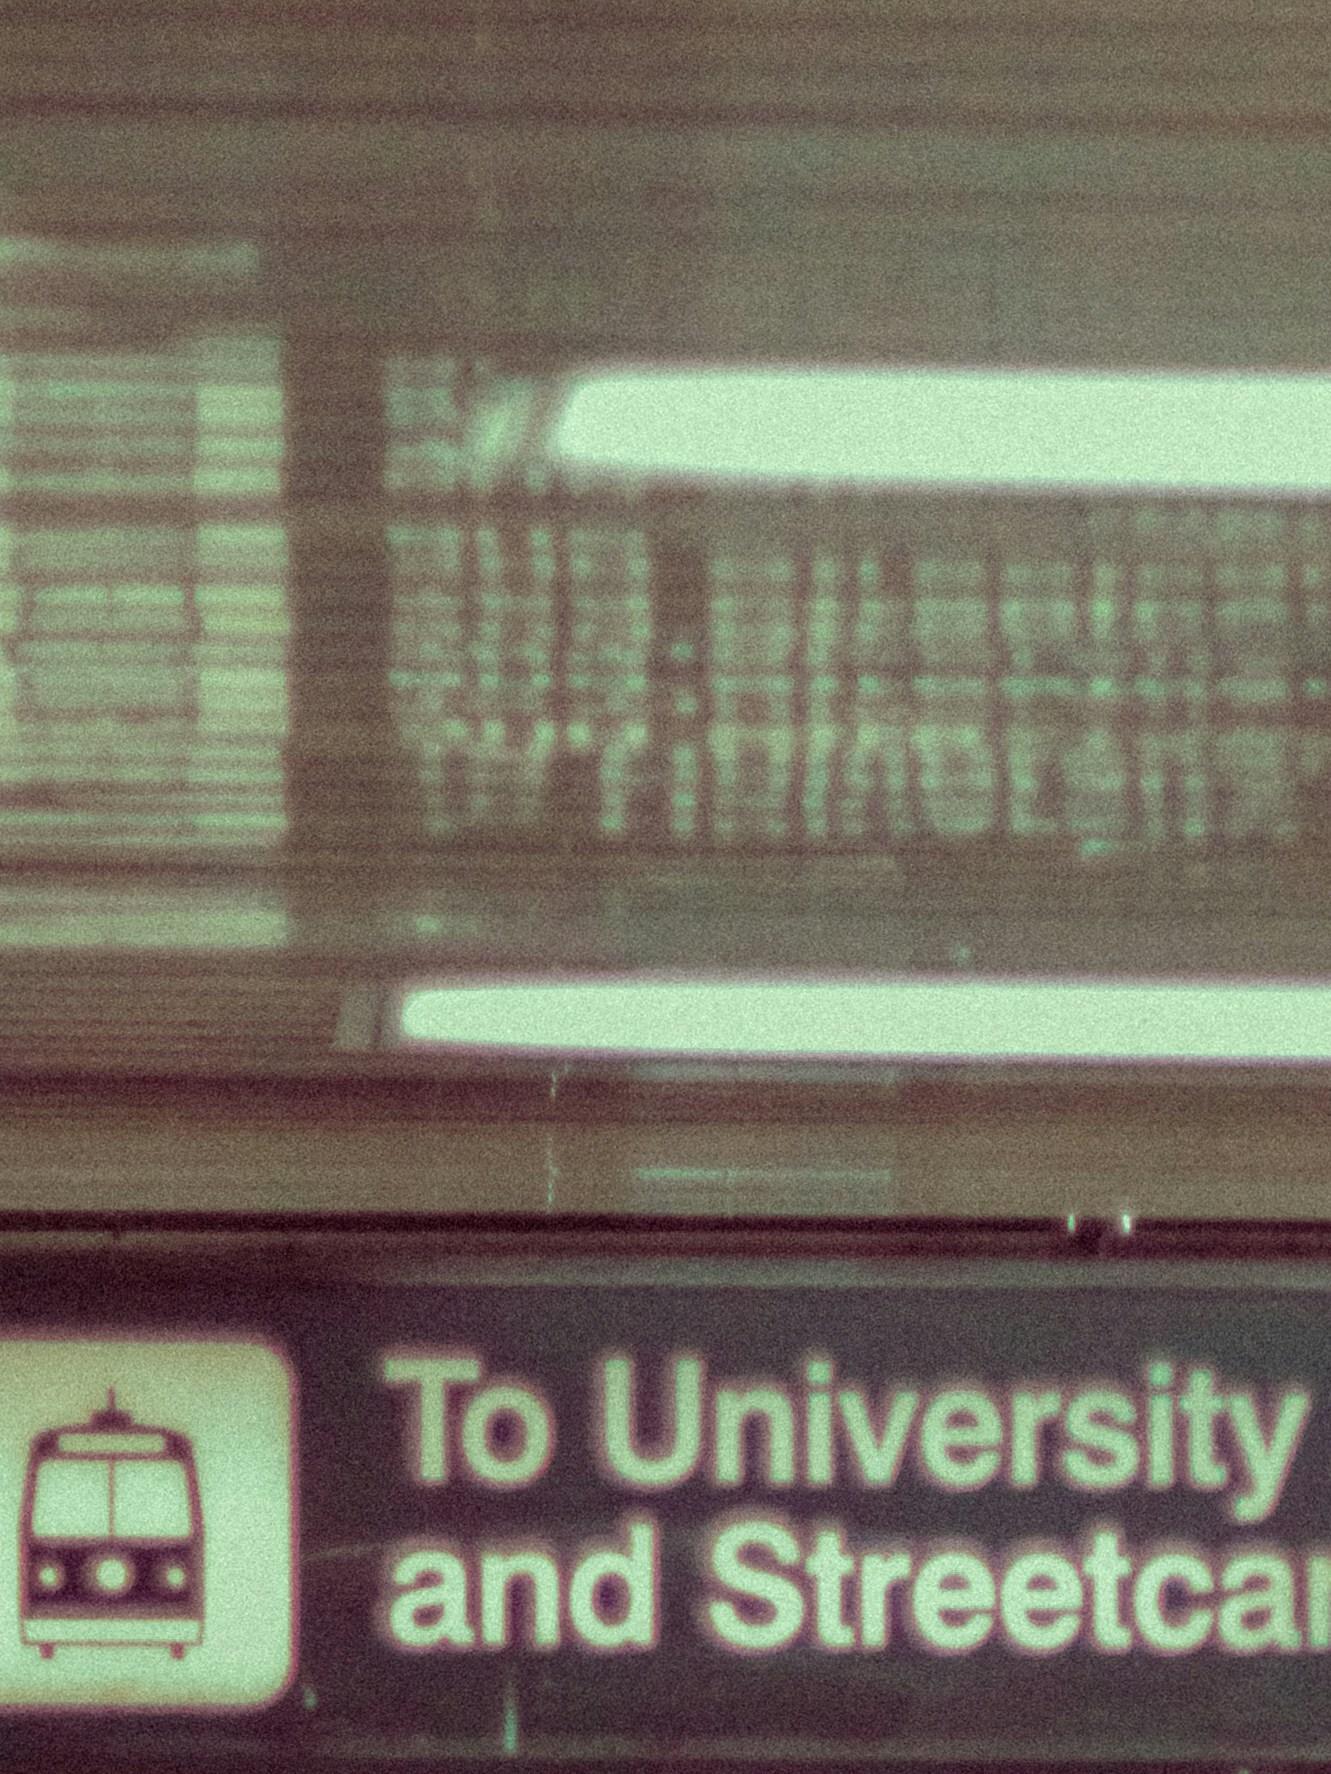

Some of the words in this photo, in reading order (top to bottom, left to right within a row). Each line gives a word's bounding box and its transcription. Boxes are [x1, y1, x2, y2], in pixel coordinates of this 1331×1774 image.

[383, 1355, 551, 1486] To
[601, 1355, 1310, 1523] University
[386, 1516, 657, 1651] and
